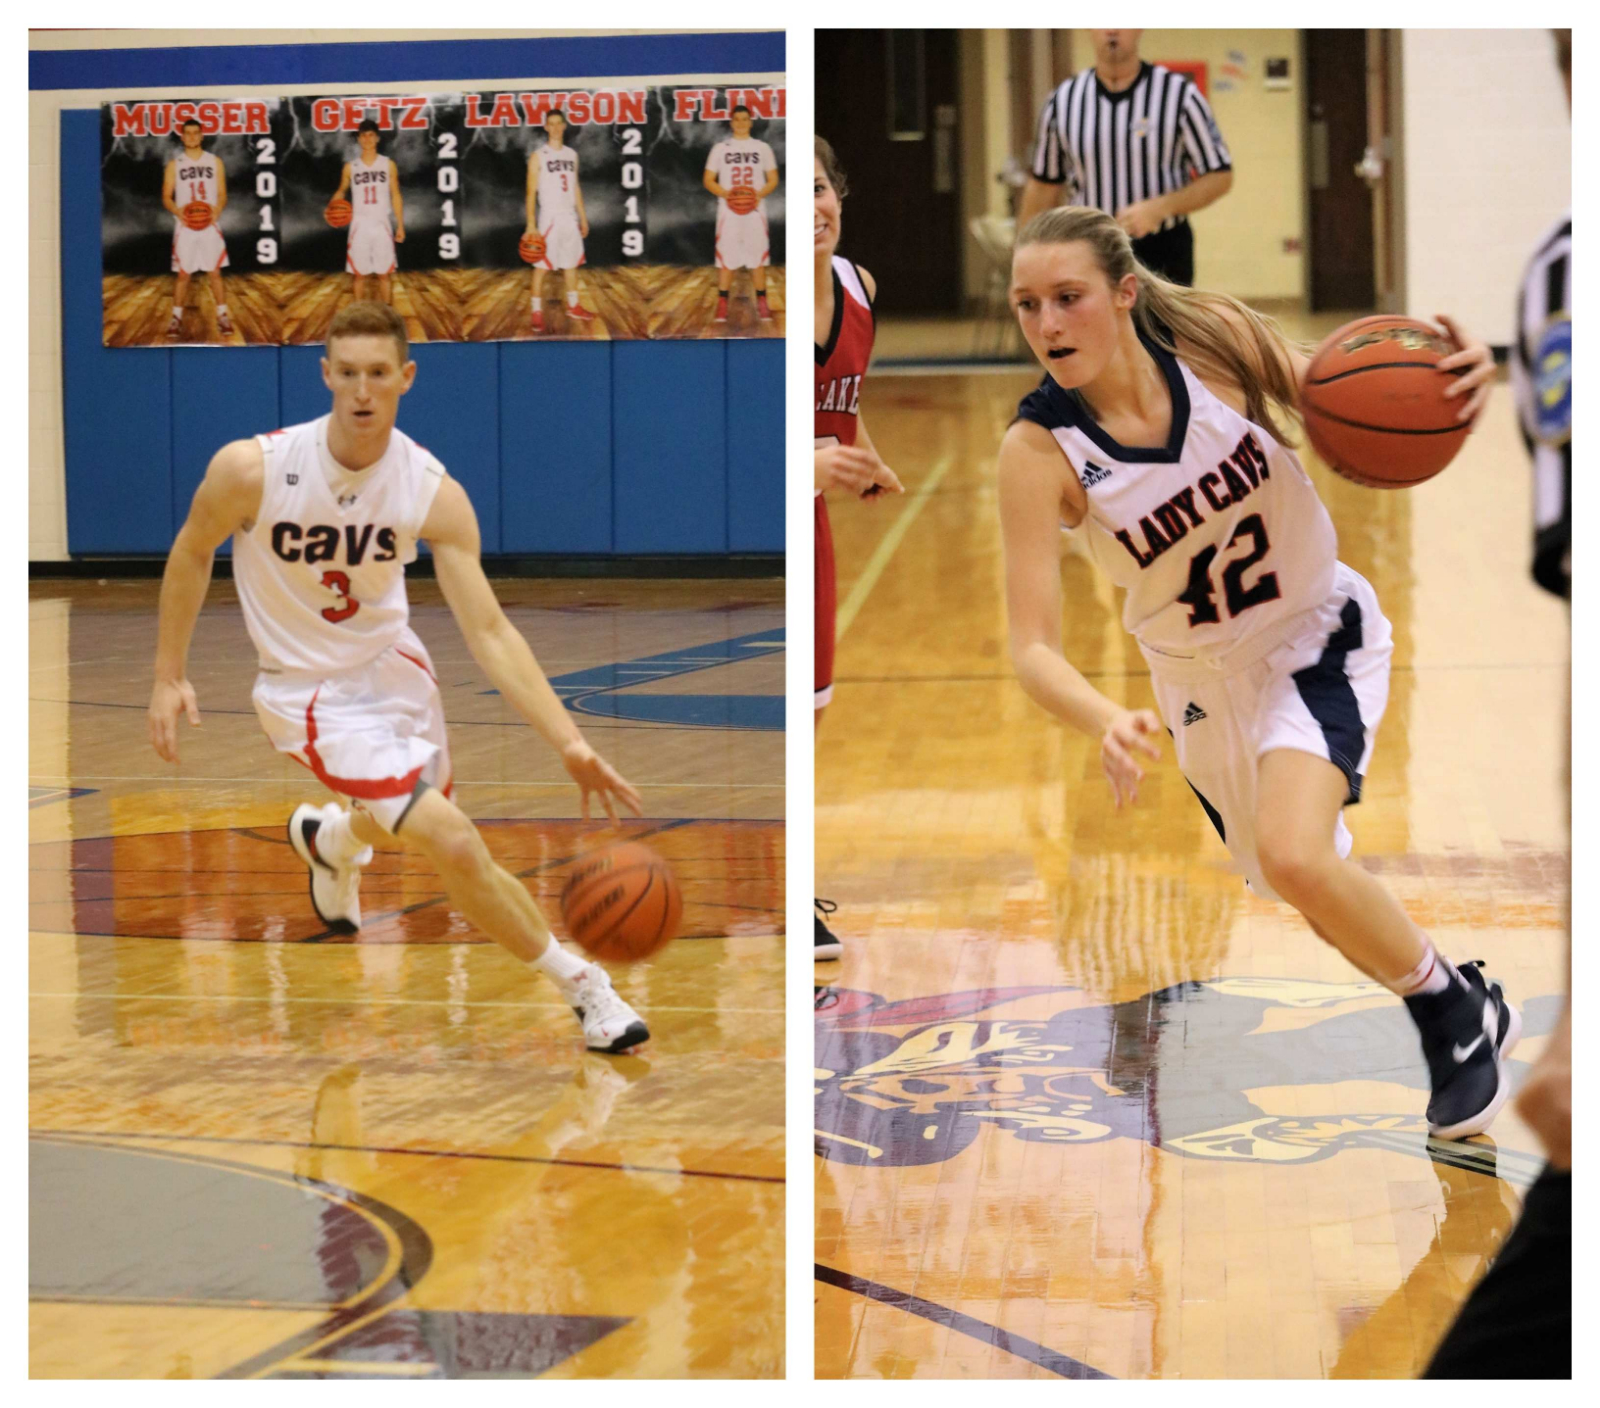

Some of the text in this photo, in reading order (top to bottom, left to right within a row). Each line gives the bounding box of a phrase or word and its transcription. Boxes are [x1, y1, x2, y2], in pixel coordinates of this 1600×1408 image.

[112, 102, 271, 137] MUSSER
[311, 97, 429, 132] GETZ
[464, 90, 648, 128] LAWSON
[672, 88, 786, 121] FLIN
[189, 181, 207, 202] 14
[363, 185, 378, 205] 11
[560, 173, 569, 192] 3
[621, 128, 644, 256] 2019
[731, 166, 754, 186] 22
[255, 137, 279, 265] 2019
[437, 132, 460, 260] 2019
[1114, 432, 1270, 569] LADY CAVS
[271, 521, 397, 566] cavs
[1175, 512, 1282, 628] 42
[320, 570, 360, 624] 3
